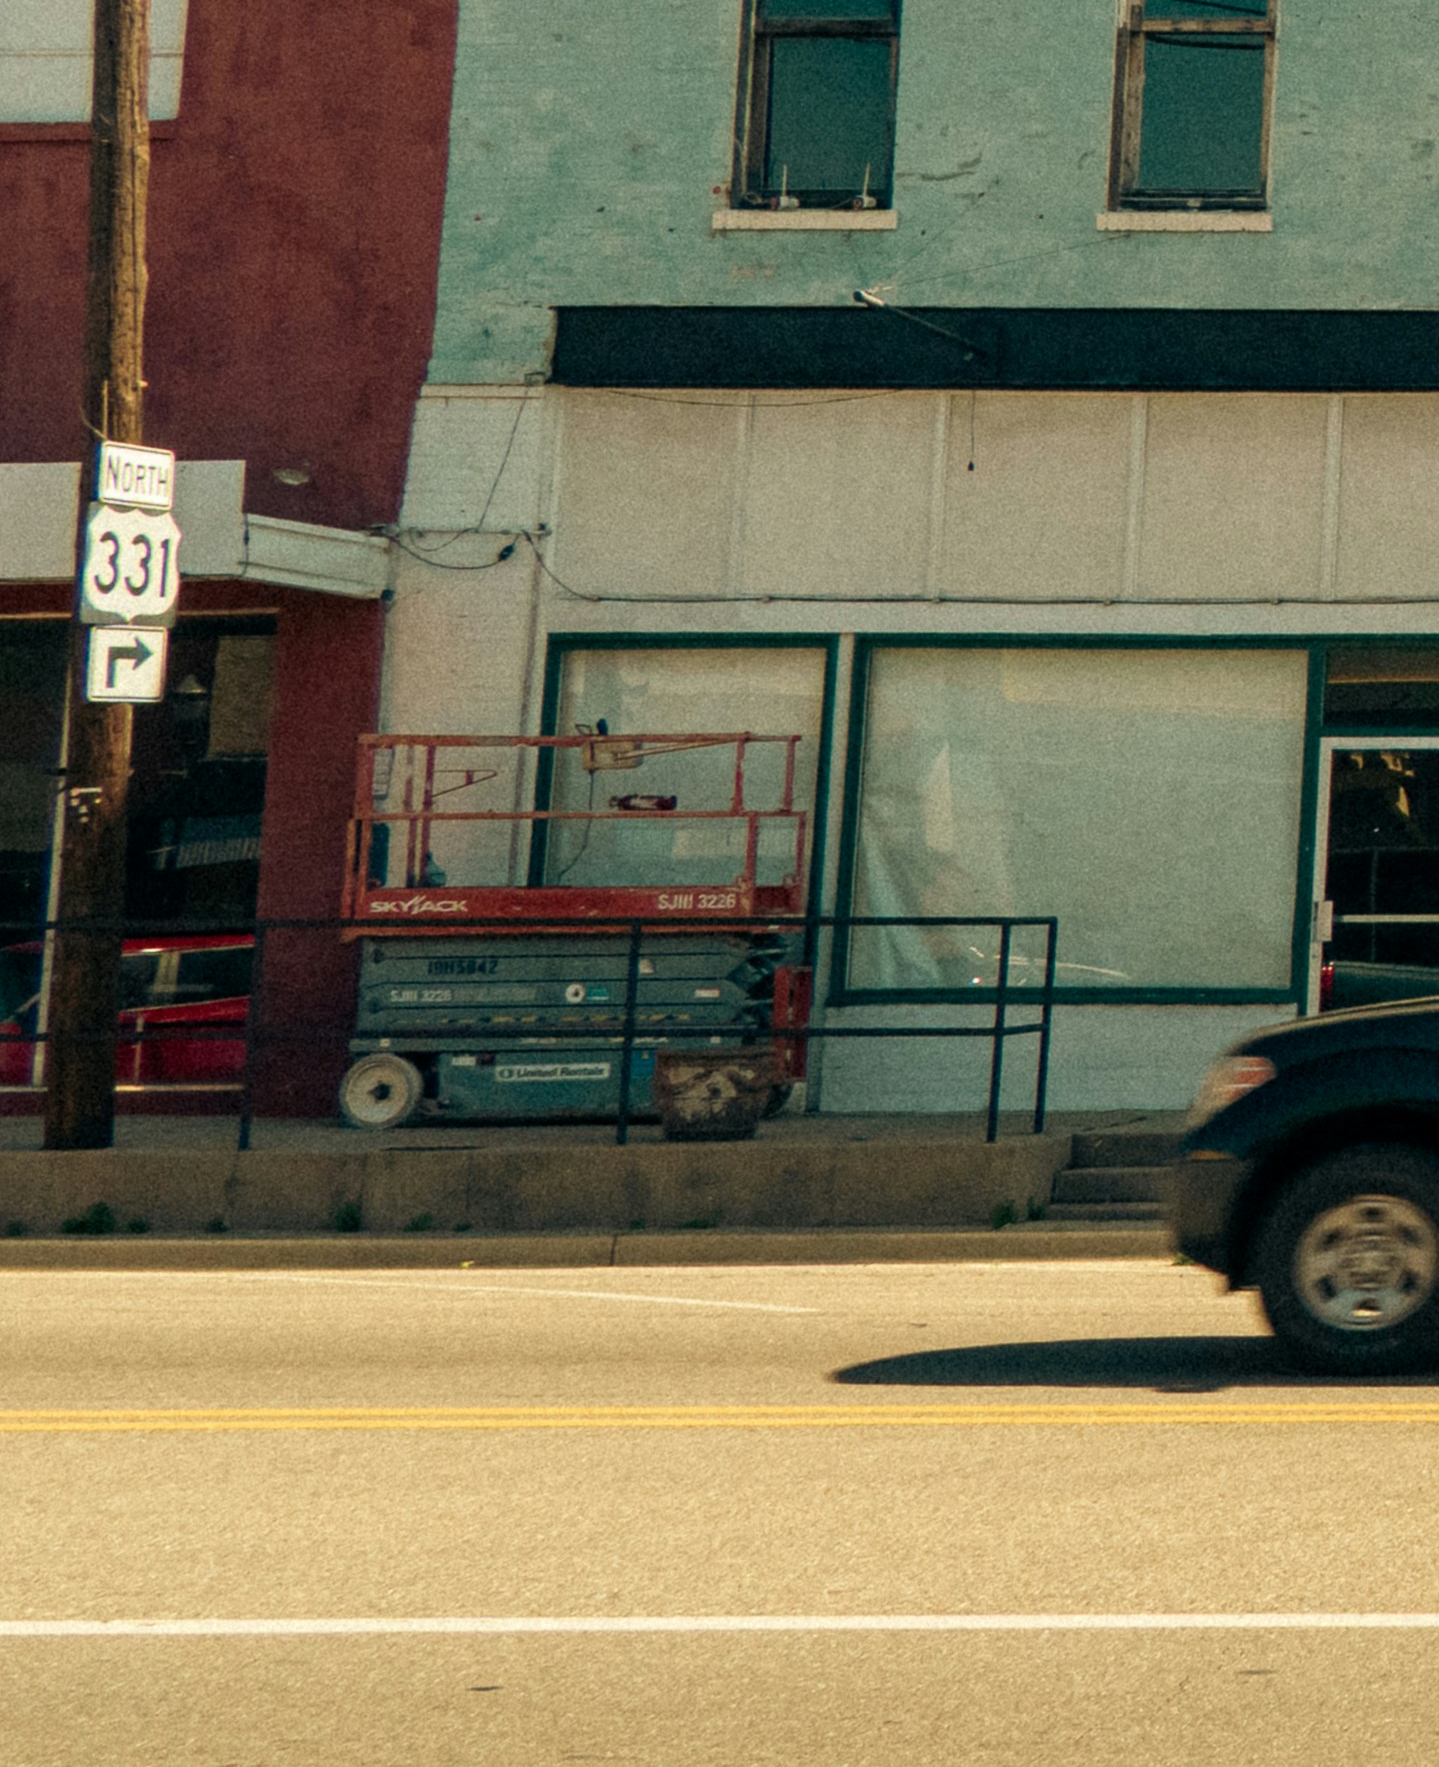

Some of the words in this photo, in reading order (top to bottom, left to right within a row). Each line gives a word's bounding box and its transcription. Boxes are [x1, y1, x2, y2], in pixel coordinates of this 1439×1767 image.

[106, 456, 169, 498] NORTH
[94, 531, 170, 598] 331
[369, 894, 469, 914] SKYJACK
[697, 892, 737, 909] 3226
[516, 1066, 557, 1078] United
